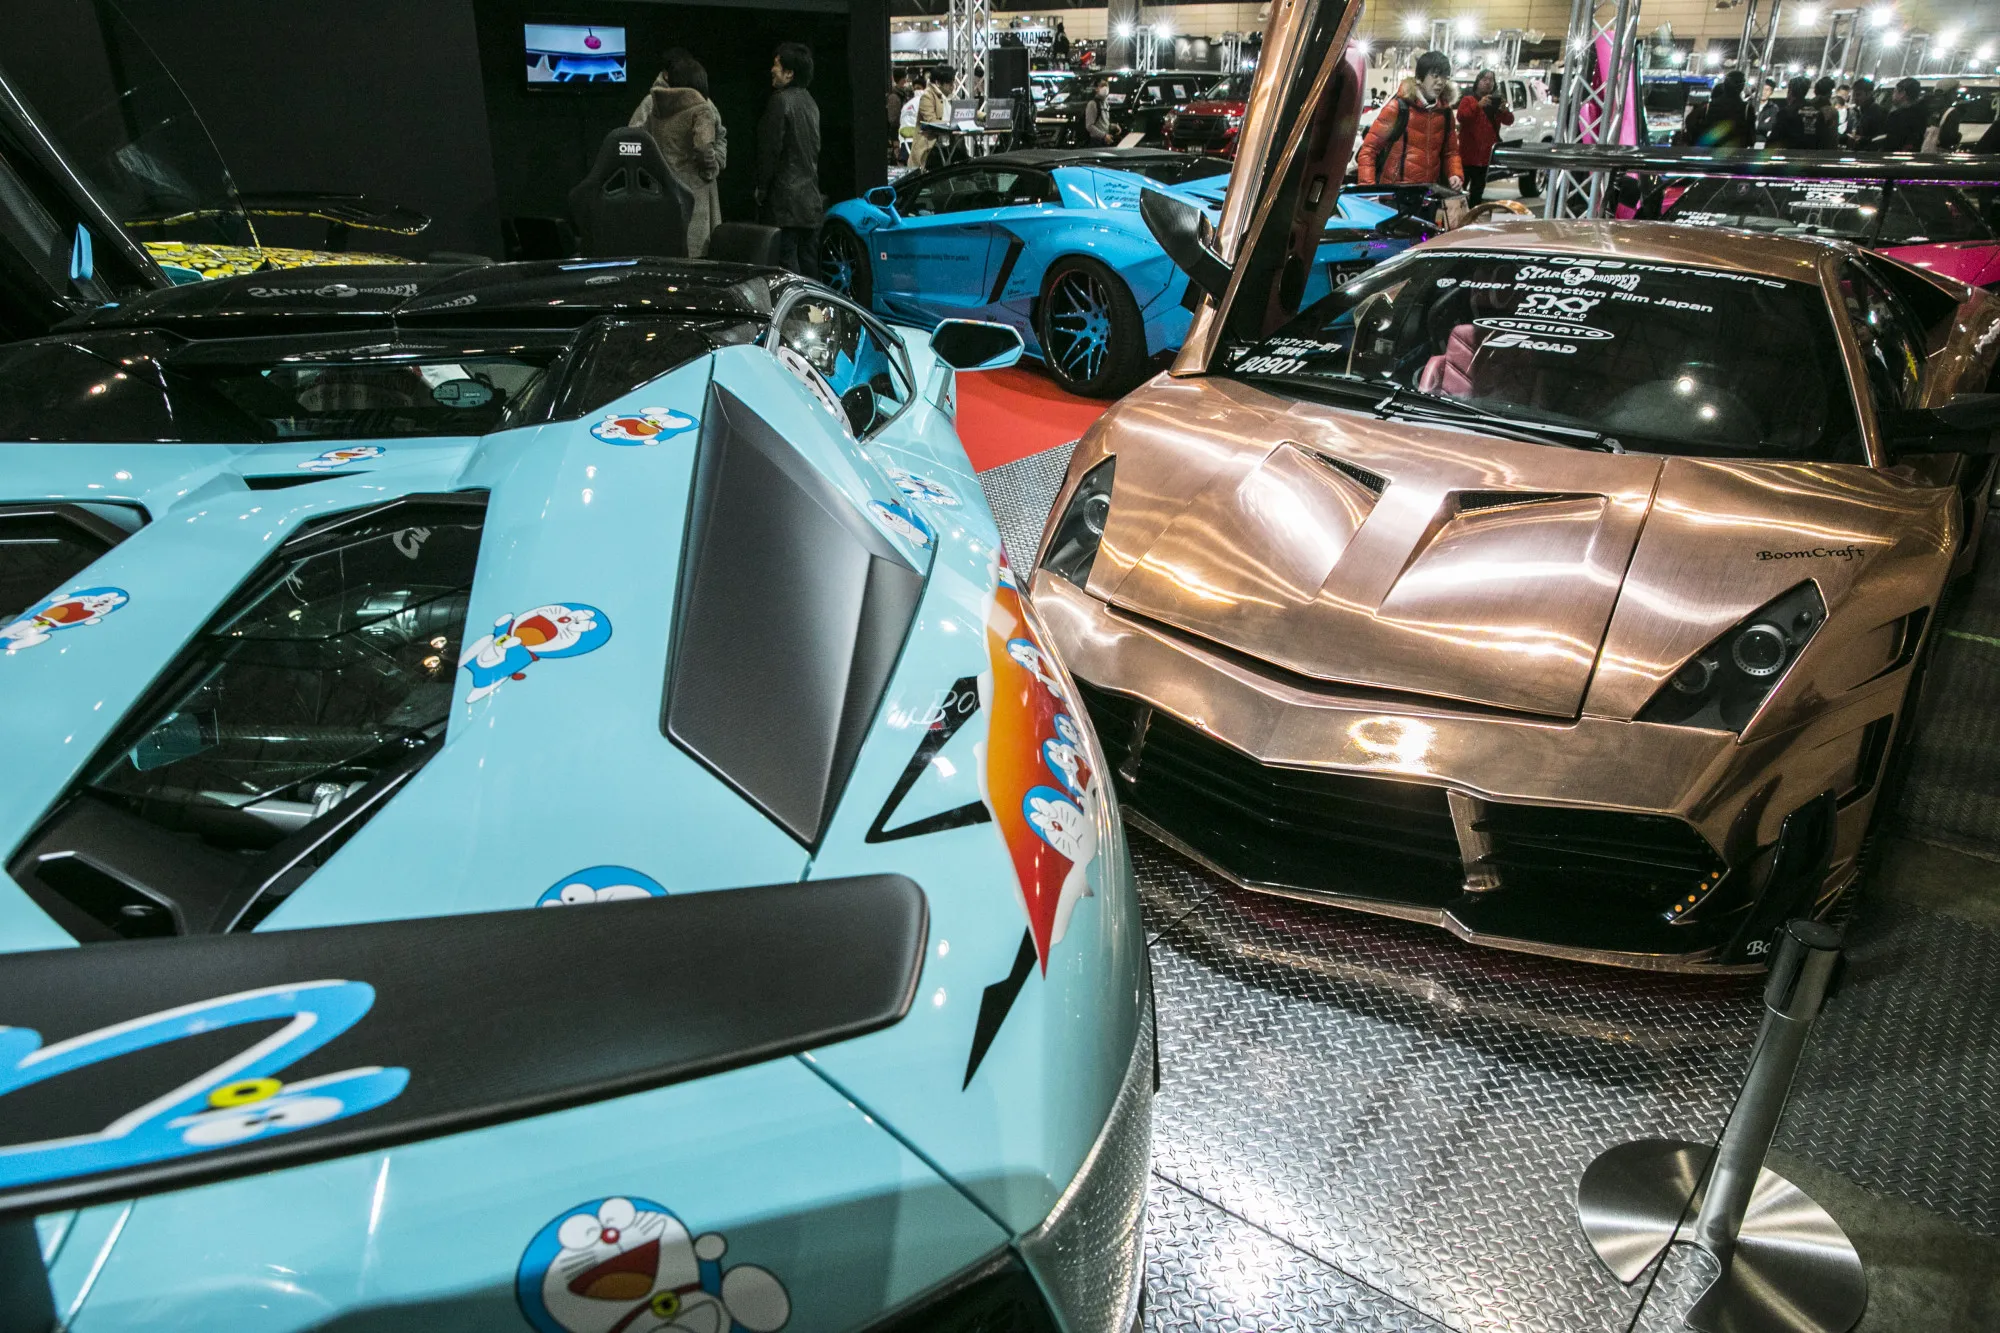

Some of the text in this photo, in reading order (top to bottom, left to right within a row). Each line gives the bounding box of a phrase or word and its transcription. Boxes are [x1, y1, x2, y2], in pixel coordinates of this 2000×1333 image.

[618, 144, 642, 154] OMP
[1549, 256, 1626, 269] 029
[1515, 265, 1640, 292] STAR DROPPER
[1459, 279, 1511, 290] Super
[1513, 282, 1607, 299] Protection
[1610, 291, 1650, 303] Film
[1654, 297, 1714, 313] Japan
[1516, 307, 1587, 319] FORGED
[1481, 319, 1605, 338] FORGIATO
[1235, 356, 1308, 375] 80901
[1756, 545, 1866, 562] BoomCraft
